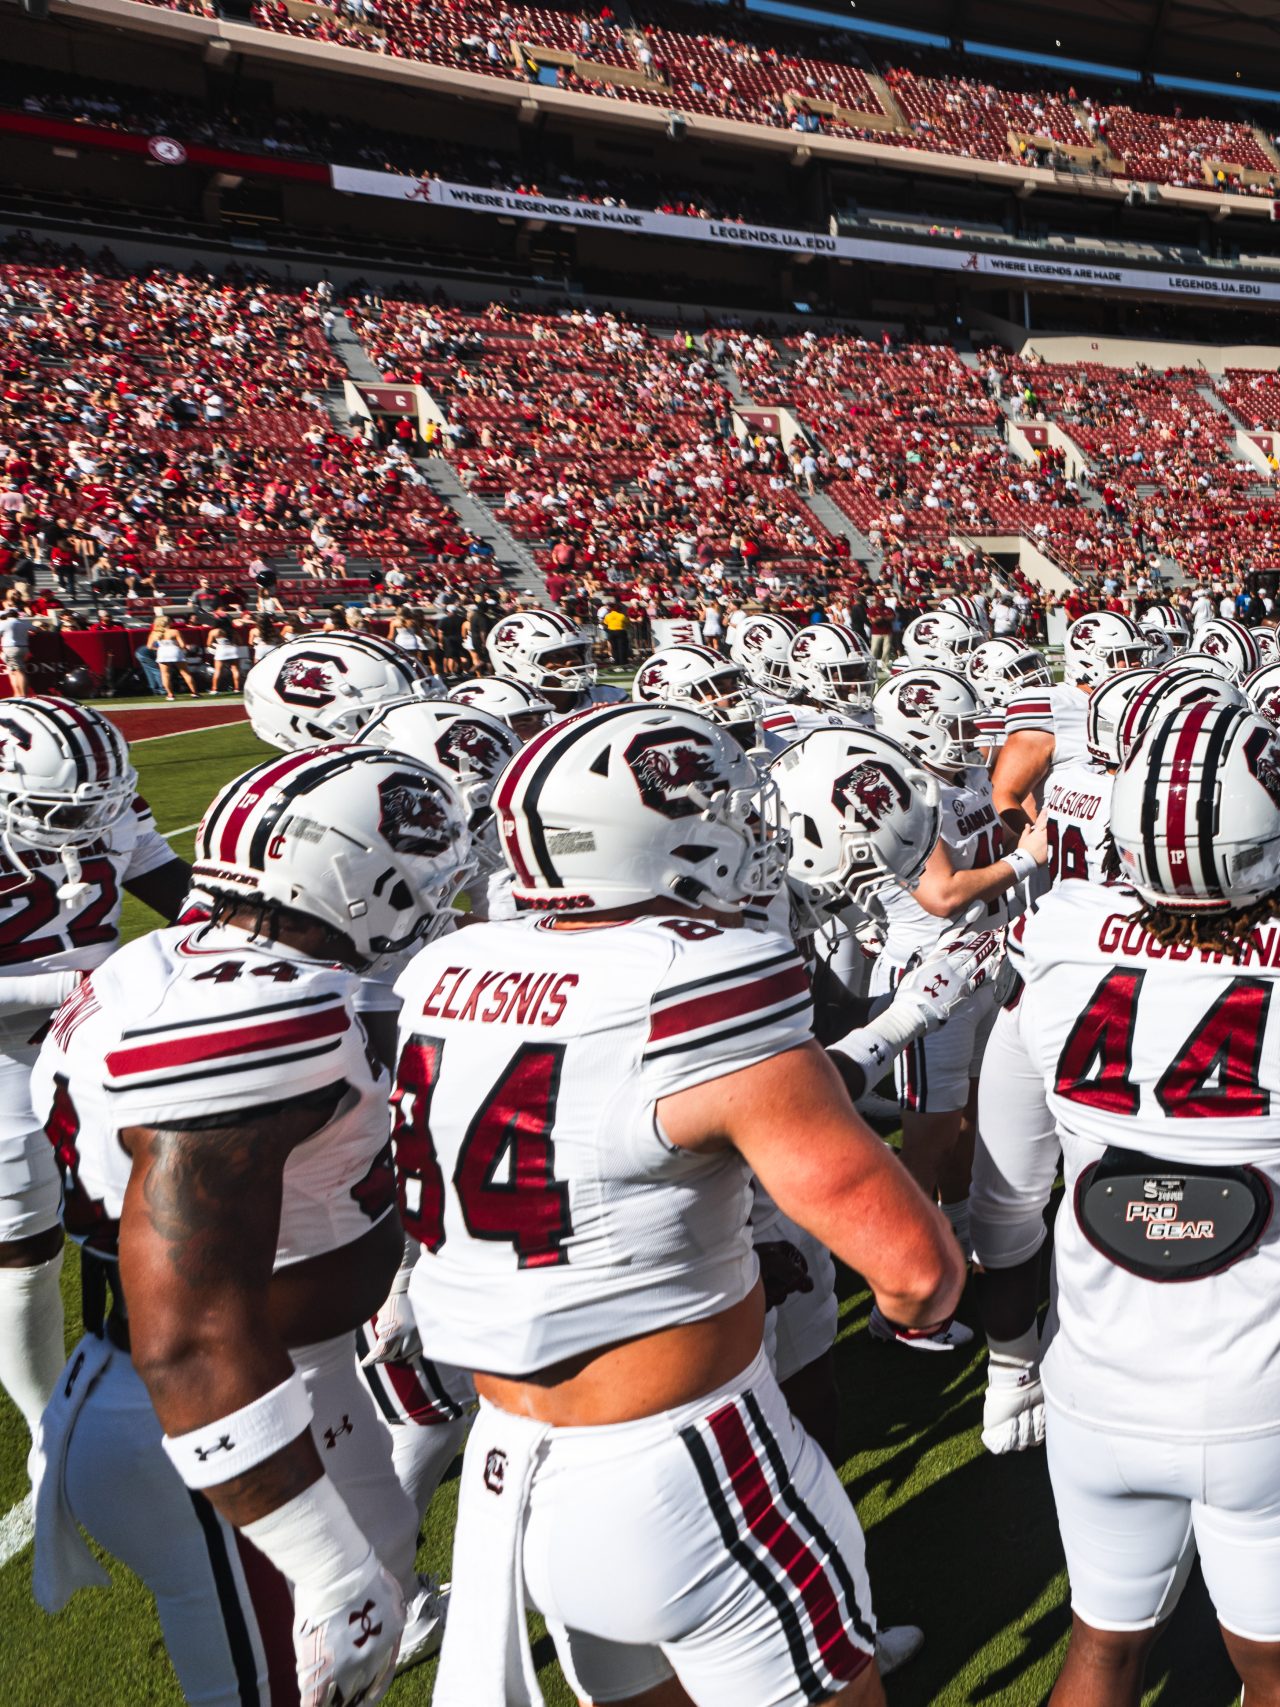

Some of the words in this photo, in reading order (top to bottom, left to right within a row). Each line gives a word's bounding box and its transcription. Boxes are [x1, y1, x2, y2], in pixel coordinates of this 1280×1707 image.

[450, 188, 504, 210] WHERE
[506, 194, 571, 218] LEGENDS
[573, 206, 600, 222] ARE
[602, 210, 643, 227] MADE
[709, 224, 837, 251] LEGENDS.UA.EDU
[990, 259, 1026, 272] WHERE
[1027, 263, 1072, 276] LEGENDS
[1073, 269, 1092, 279] ARE
[1093, 271, 1121, 281] MADE
[1168, 277, 1261, 295] LEGENDS.UA.EDU
[1170, 849, 1186, 865] IP
[0, 856, 120, 967] 22
[192, 960, 300, 985] 44
[422, 965, 580, 1027] ELKSNIS
[1053, 964, 1275, 1119] 44
[1125, 1201, 1178, 1222] PRO
[1146, 1221, 1215, 1240] GEAR
